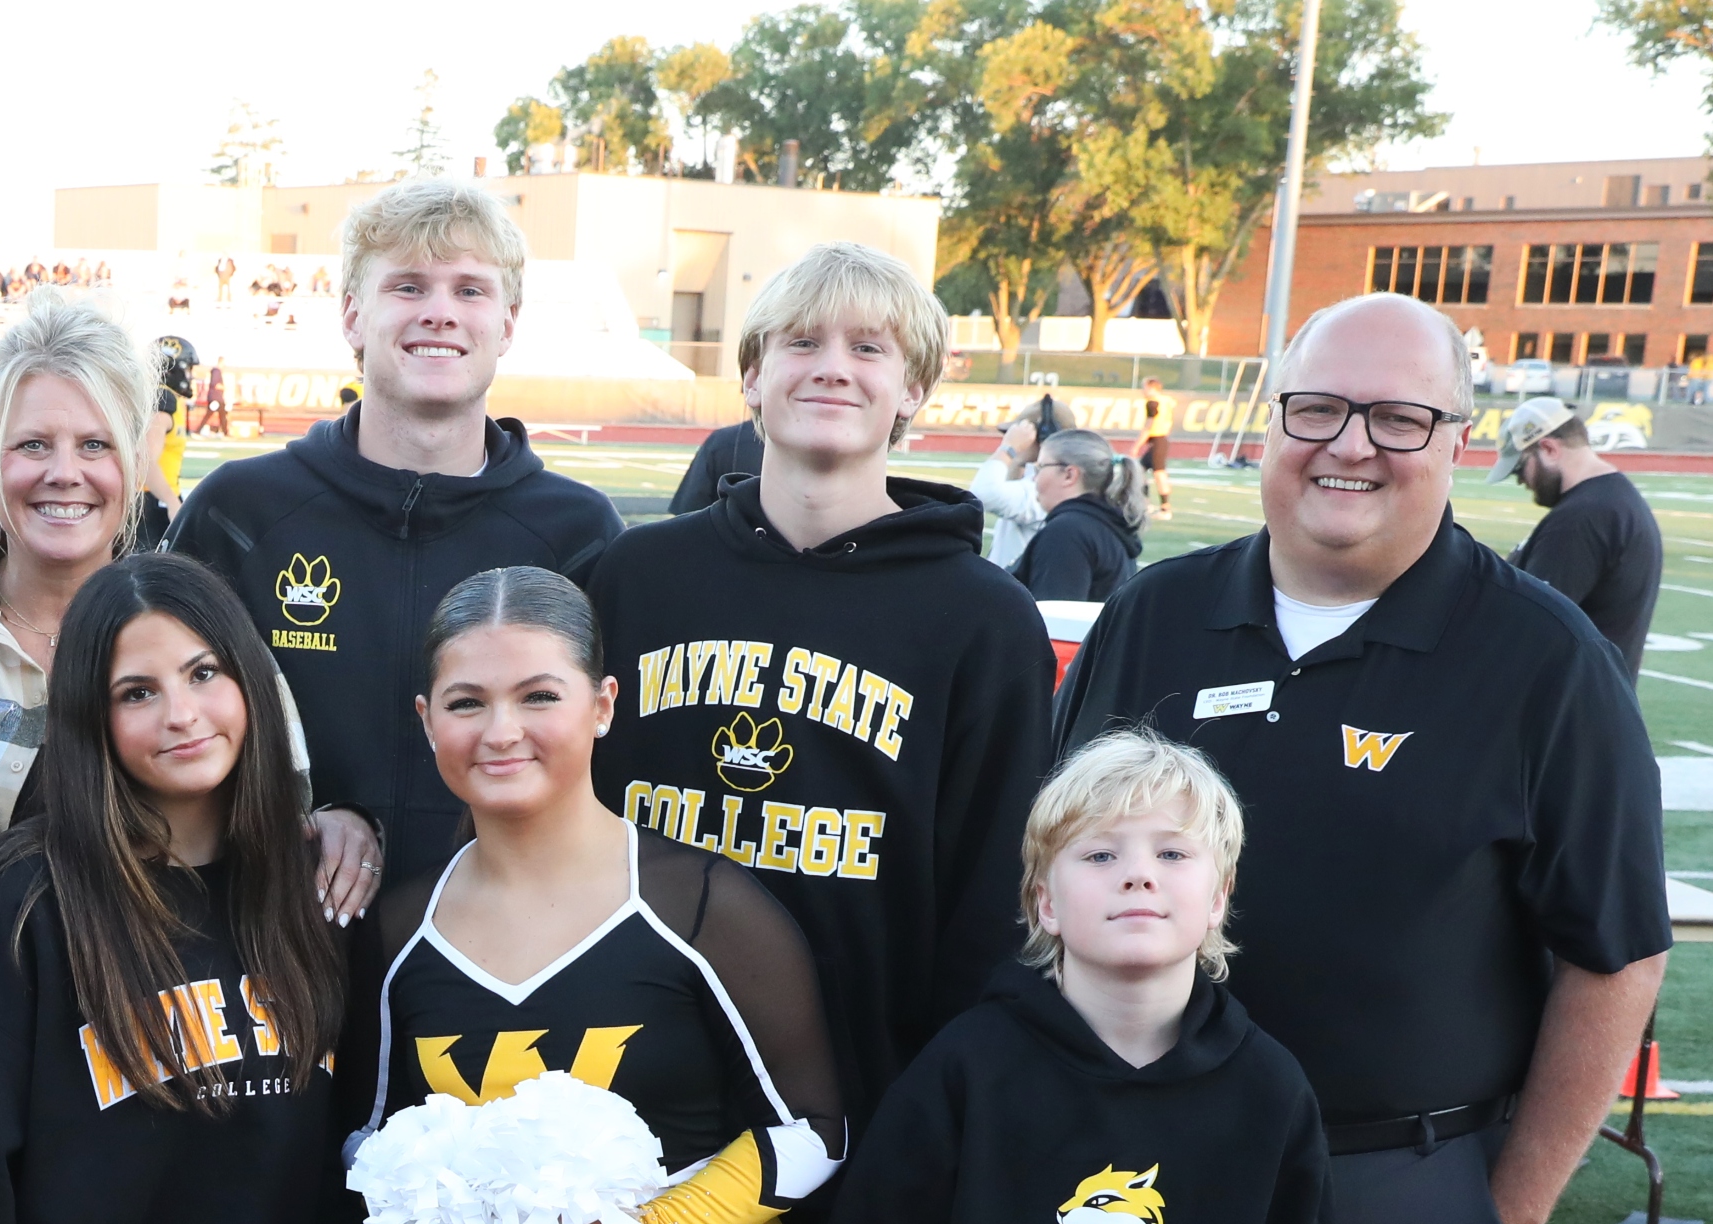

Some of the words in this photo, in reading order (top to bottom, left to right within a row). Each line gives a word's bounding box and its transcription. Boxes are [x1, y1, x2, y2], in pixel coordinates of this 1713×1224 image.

[285, 585, 328, 603] WSC
[271, 629, 337, 652] BASEBALL
[638, 640, 774, 718] WAYNE
[777, 646, 914, 762] STATE
[721, 744, 777, 769] WSC
[1341, 723, 1415, 772] W
[624, 779, 887, 881] COLLEGE
[196, 1078, 291, 1100] COLLEGE
